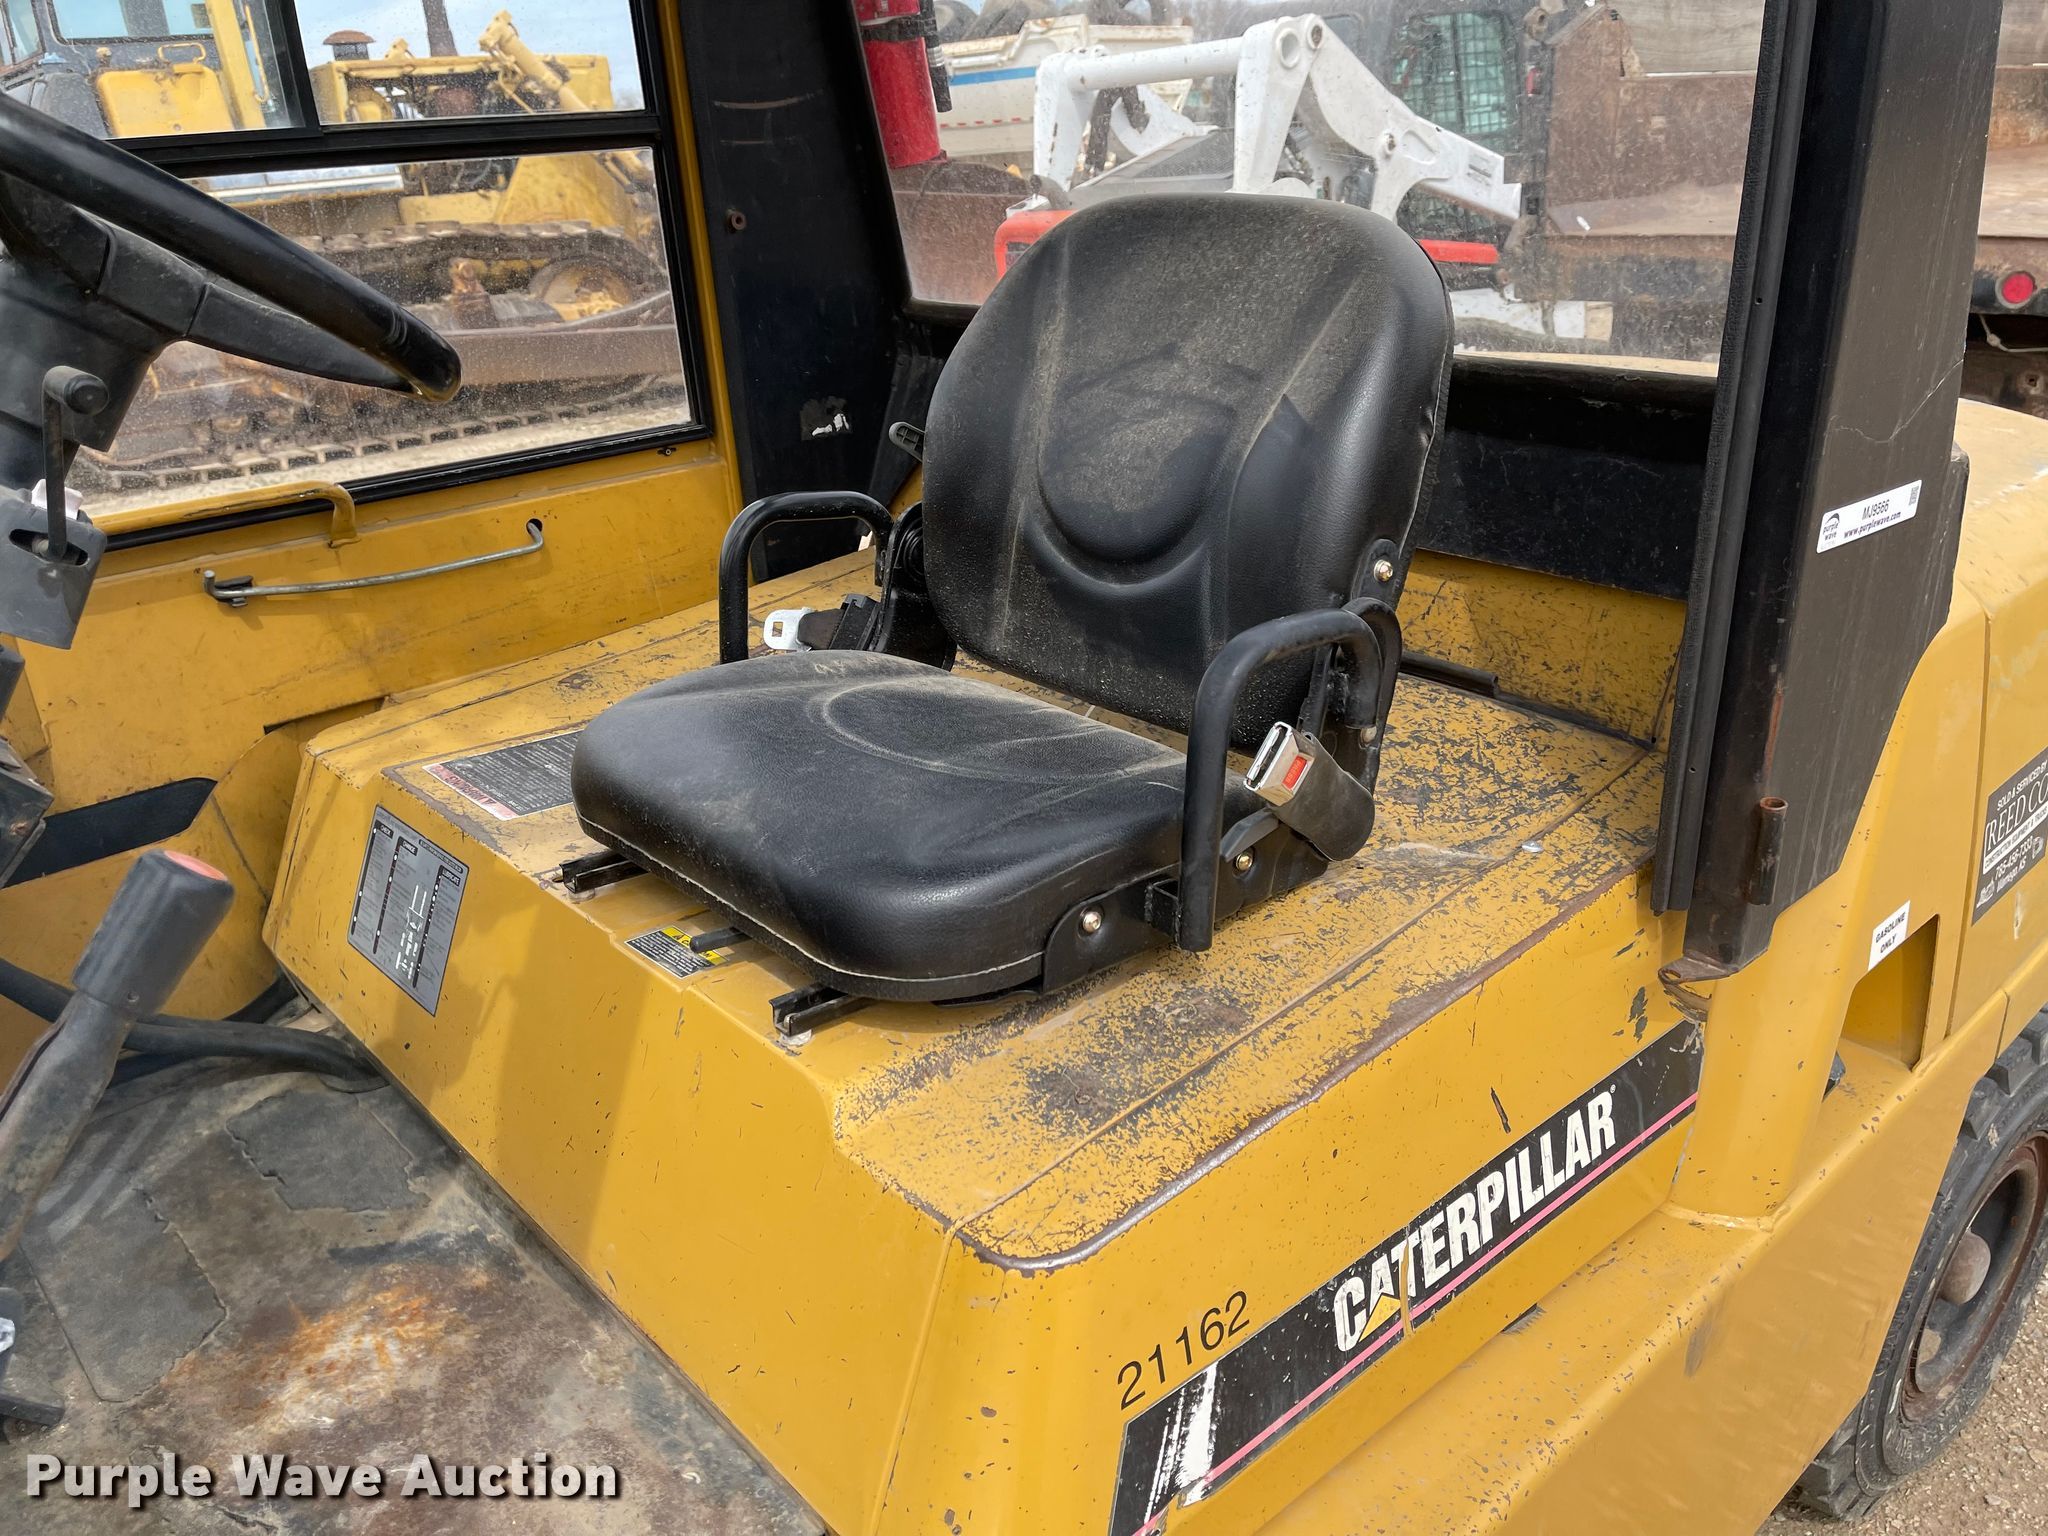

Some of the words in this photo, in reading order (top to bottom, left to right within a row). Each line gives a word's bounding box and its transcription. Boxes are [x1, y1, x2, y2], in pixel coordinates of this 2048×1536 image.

[1843, 511, 1902, 538] www.purplewave.com
[1862, 499, 1890, 520] MJ9566
[1987, 794, 2026, 851] REED
[1876, 912, 1906, 943] GASOLINE
[1880, 933, 1897, 953] ONLY
[1333, 1090, 1616, 1352] CATERPILLAR
[1117, 1290, 1251, 1411] 21162
